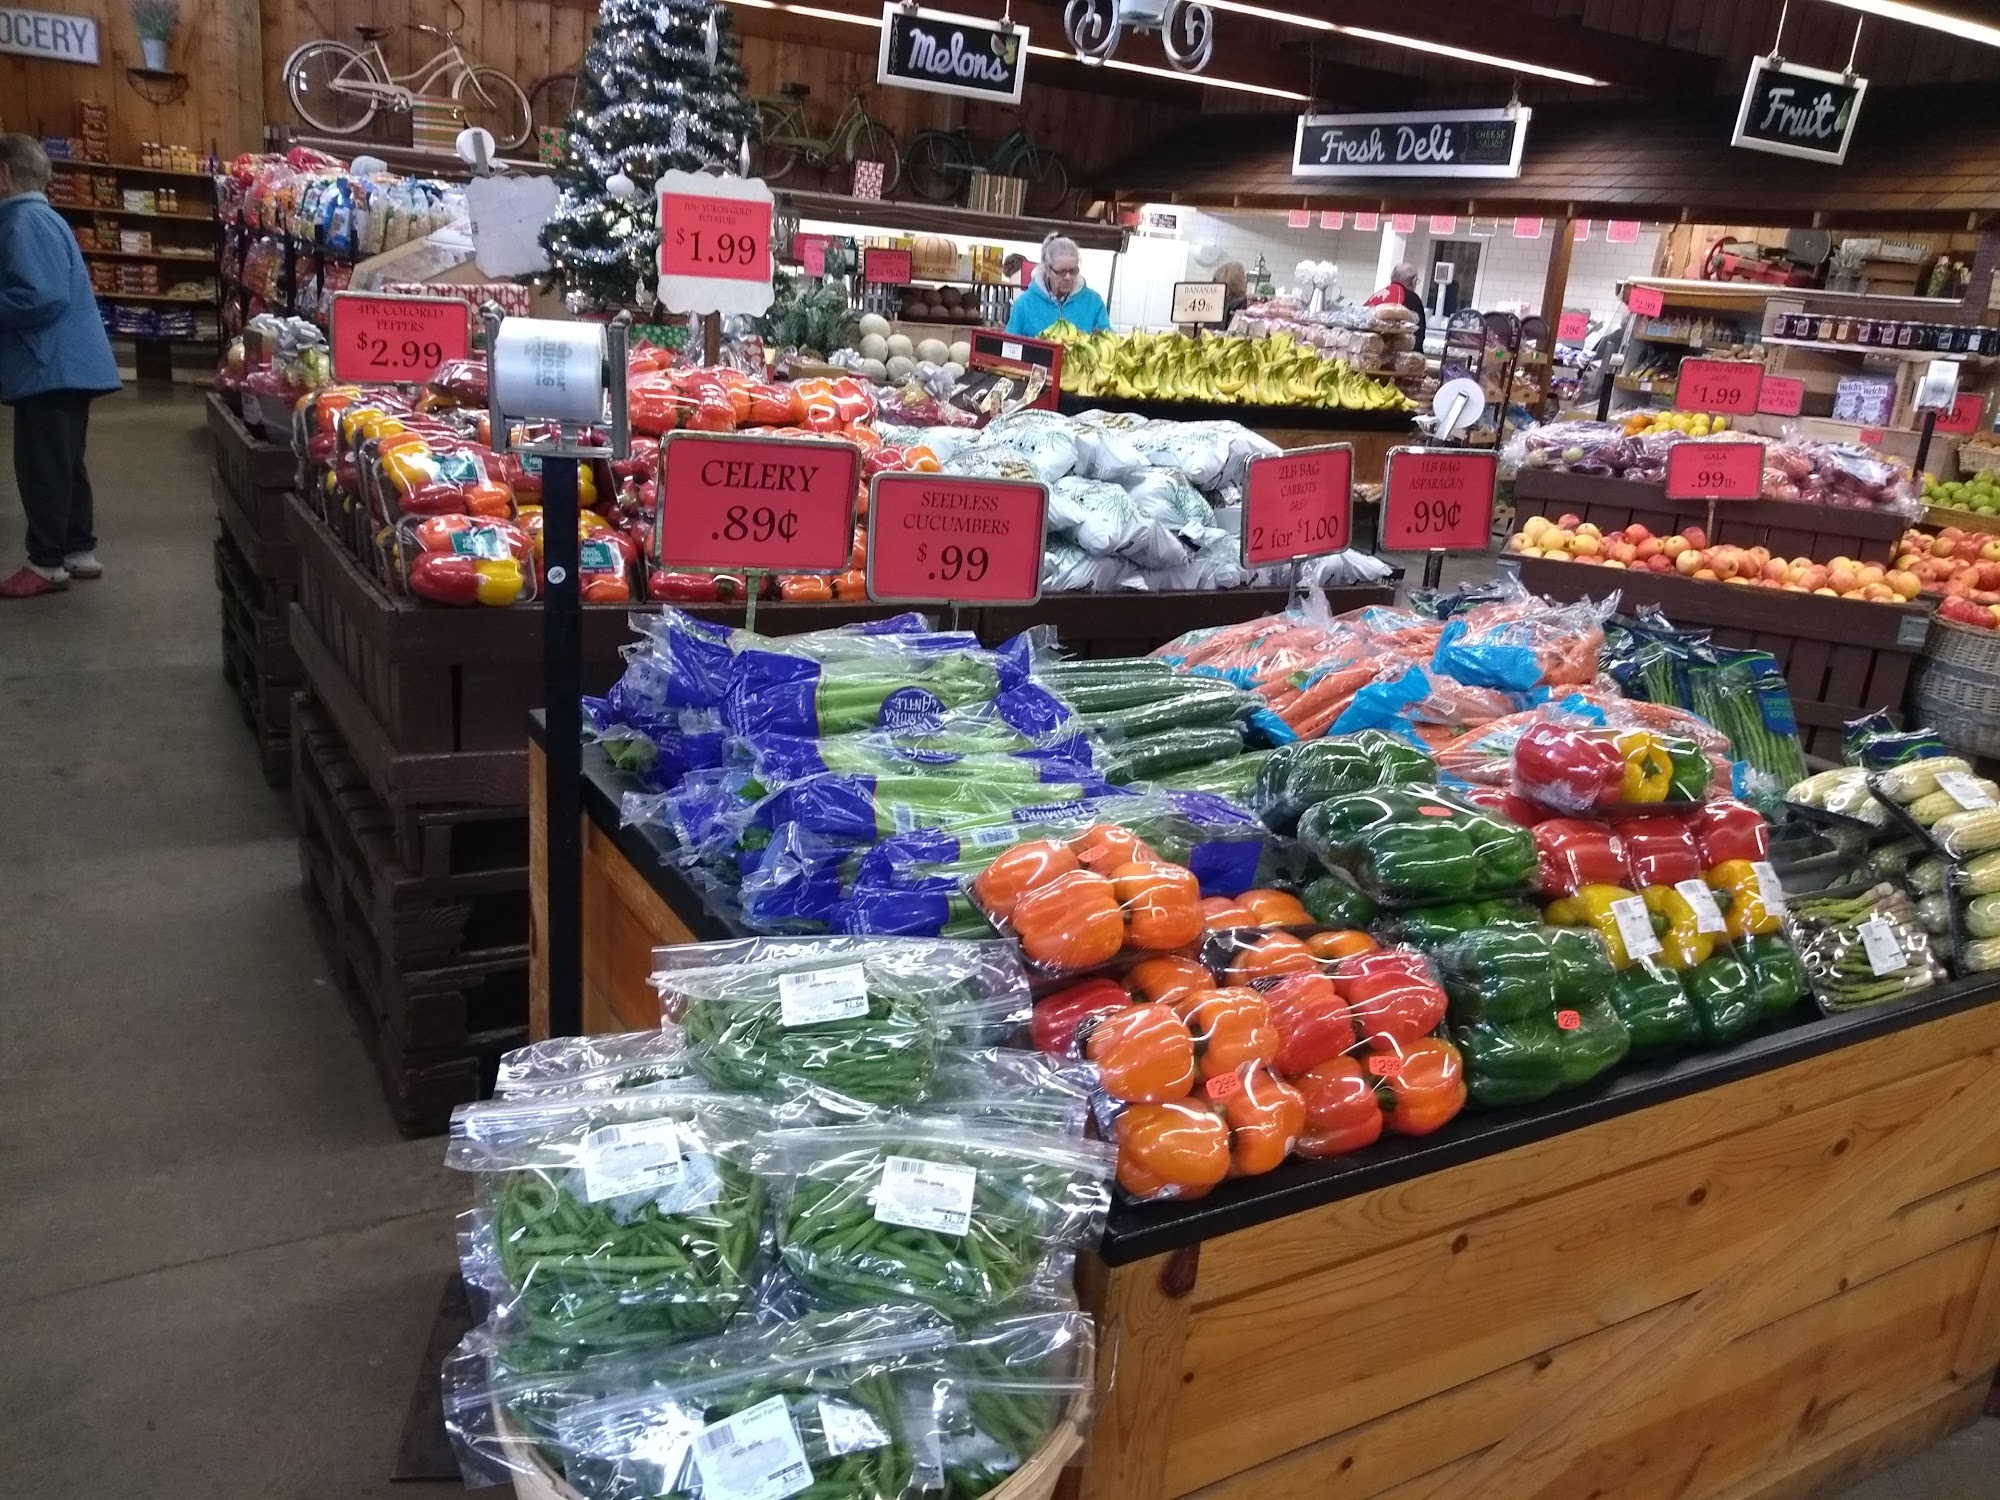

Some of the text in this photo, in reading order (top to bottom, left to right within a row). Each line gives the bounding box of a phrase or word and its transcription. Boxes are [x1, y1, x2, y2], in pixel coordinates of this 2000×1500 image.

[908, 27, 1009, 82] Melons
[1760, 87, 1836, 139] Fruit
[1319, 123, 1454, 163] Fresh Deli
[676, 227, 756, 266] $1.99
[1184, 286, 1218, 295] BANANAS
[383, 305, 444, 319] COLORED
[376, 320, 424, 332] PEPPERS
[357, 330, 442, 369] $2.99
[1691, 384, 1741, 405] $1.99
[1863, 385, 1886, 395] Welch's
[1439, 461, 1461, 473] BAG
[1703, 453, 1727, 461] GALA
[700, 459, 820, 493] CELERY
[1279, 461, 1319, 480] 2LB BAG
[1691, 471, 1736, 488] .99lb
[1280, 481, 1317, 498] CARROTS
[1408, 478, 1464, 490] ASPARAGUS
[920, 490, 999, 512] SEEDLESS
[711, 504, 799, 544] .89¢
[903, 513, 1010, 536] CUCUMBERS
[1405, 500, 1462, 534] .99¢
[1251, 515, 1339, 551] 2 for $1.00
